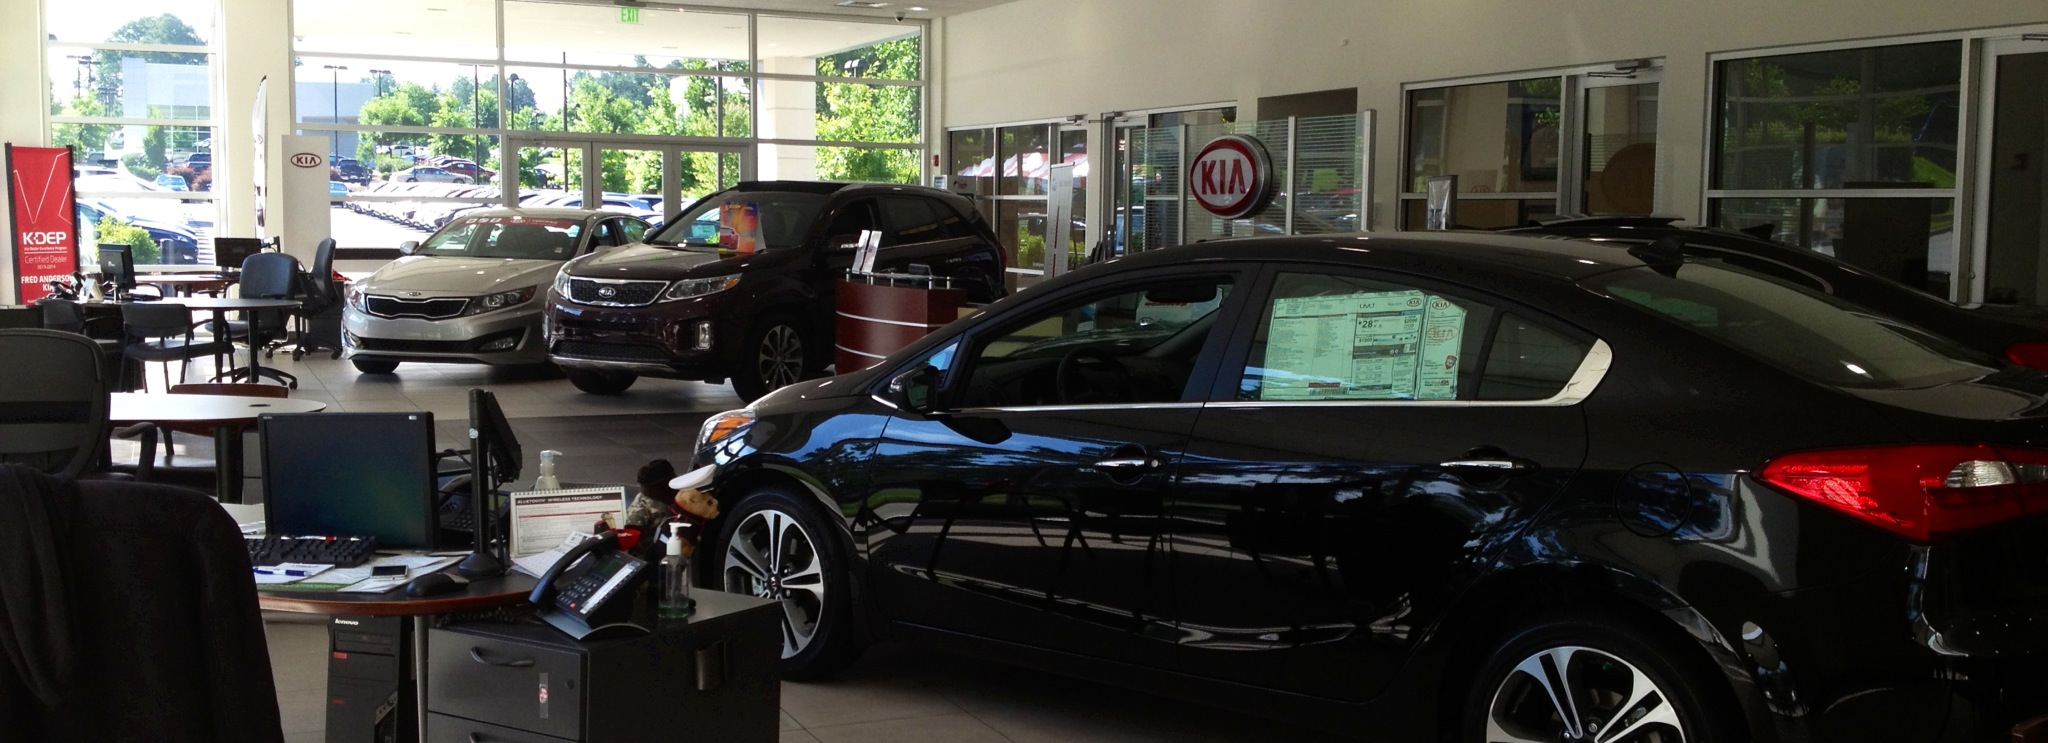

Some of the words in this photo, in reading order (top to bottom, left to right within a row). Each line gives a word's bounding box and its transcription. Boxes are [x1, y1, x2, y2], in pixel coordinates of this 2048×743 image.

[621, 7, 639, 23] EXIT
[296, 156, 317, 165] KIA
[1201, 158, 1246, 195] KIA
[24, 256, 49, 264] Certified
[21, 276, 38, 284] FRED
[1361, 320, 1373, 328] 28
[334, 618, 359, 626] lenovo
